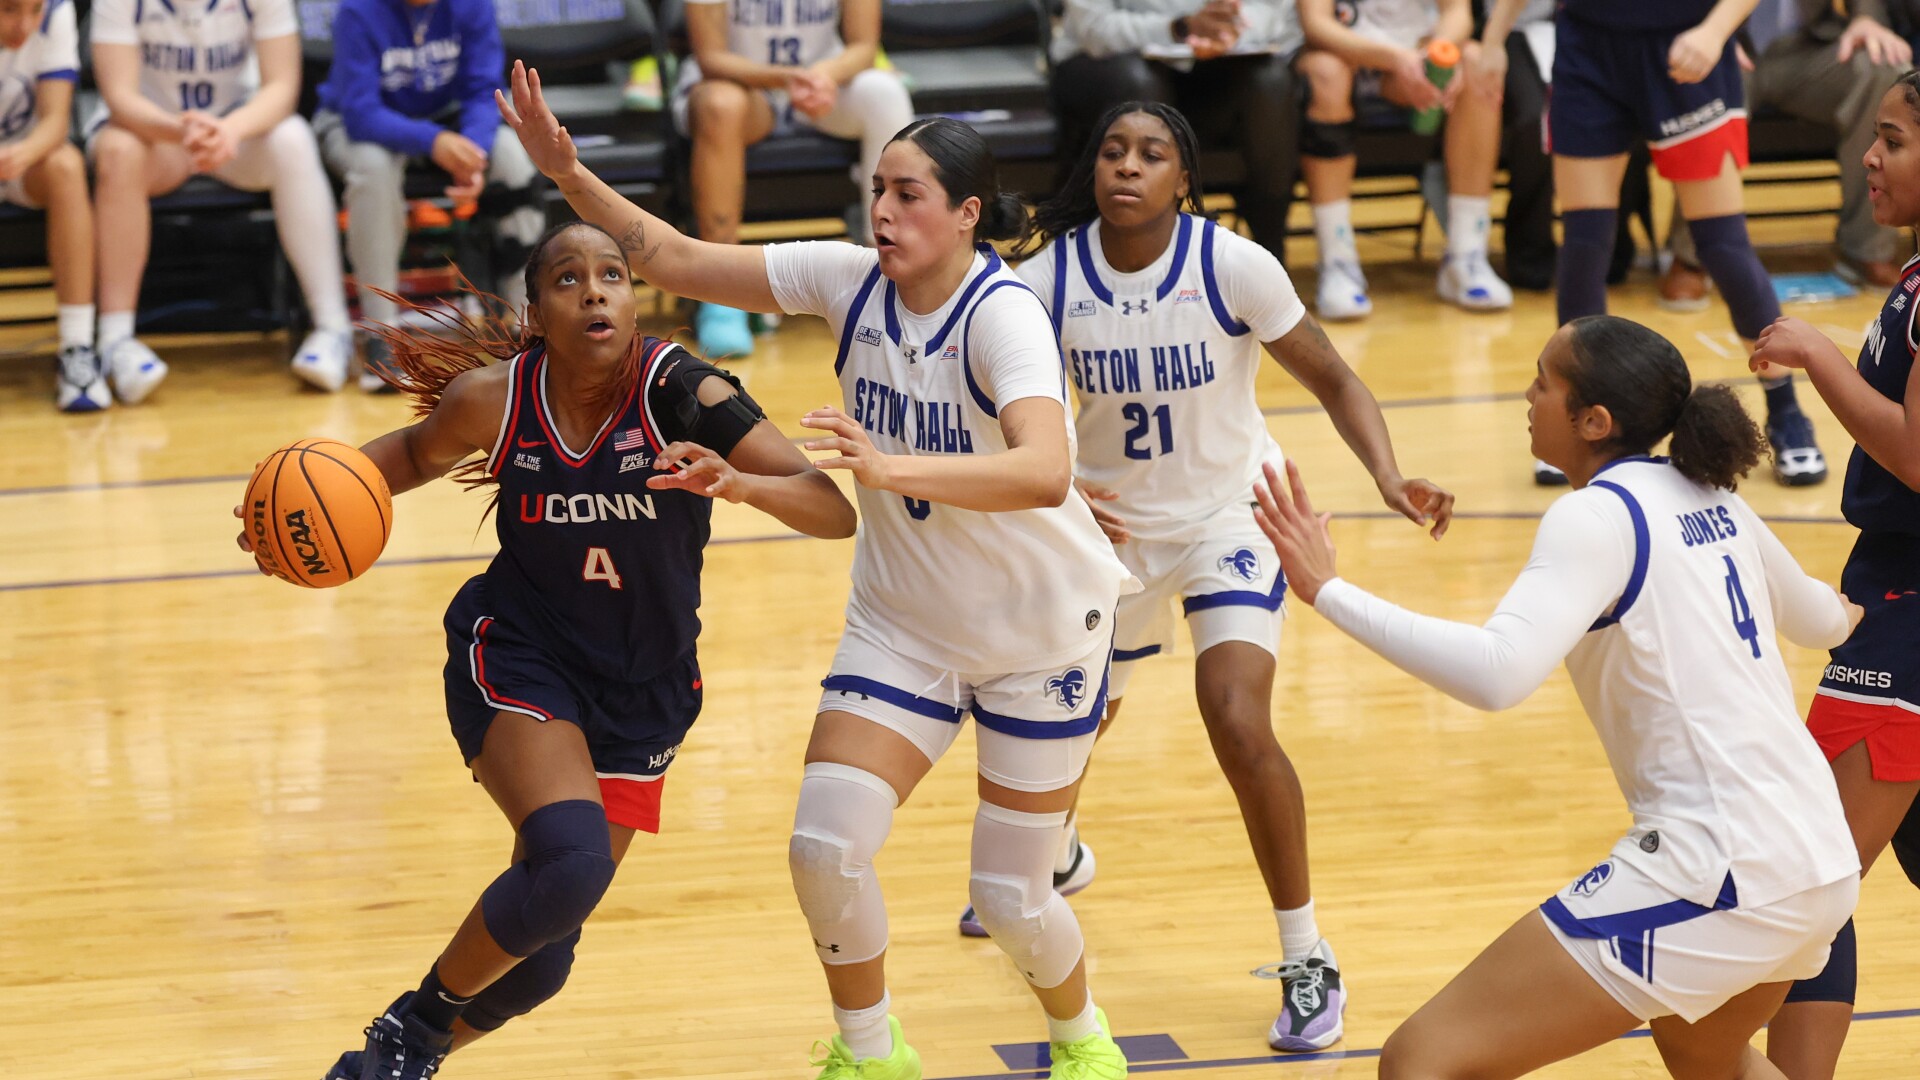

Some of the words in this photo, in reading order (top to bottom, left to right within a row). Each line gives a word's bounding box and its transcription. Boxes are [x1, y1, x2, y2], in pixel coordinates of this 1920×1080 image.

[768, 37, 800, 66] 13
[179, 81, 214, 111] 10
[855, 333, 880, 346] CHANGE
[860, 326, 868, 335] BE
[869, 329, 881, 339] THE
[1071, 348, 1142, 394] SETON
[1150, 341, 1215, 391] HALL
[855, 377, 908, 443] SETON
[915, 400, 974, 453] HALL
[1122, 402, 1174, 460] 21
[513, 459, 541, 471] CHANGE
[516, 453, 526, 462] BE
[527, 455, 541, 465] THE
[620, 457, 651, 470] EAST
[622, 452, 644, 463] BIG
[520, 493, 657, 524] UCONN
[1676, 505, 1737, 547] JONES
[285, 509, 330, 575] NCAA
[582, 547, 623, 590] 4
[1721, 554, 1762, 660] 4
[1824, 664, 1892, 688] HUSKIES
